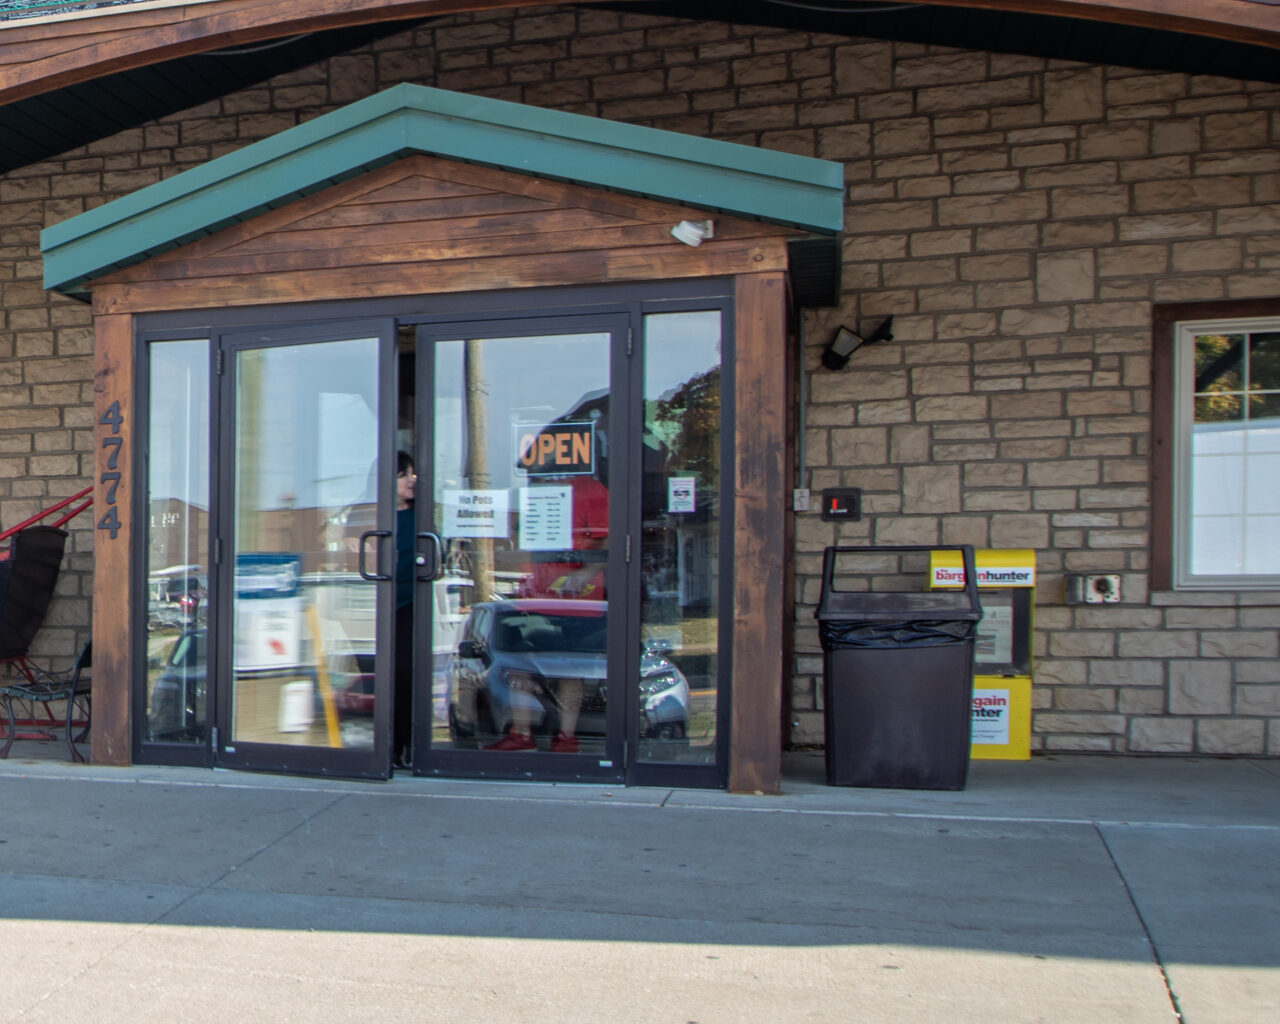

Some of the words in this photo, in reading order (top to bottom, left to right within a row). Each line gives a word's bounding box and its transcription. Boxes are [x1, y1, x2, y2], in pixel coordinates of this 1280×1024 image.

[520, 432, 591, 466] OPEN
[97, 400, 125, 540] 4774
[458, 495, 471, 504] No
[472, 495, 494, 504] Pets
[456, 509, 495, 518] Allowed
